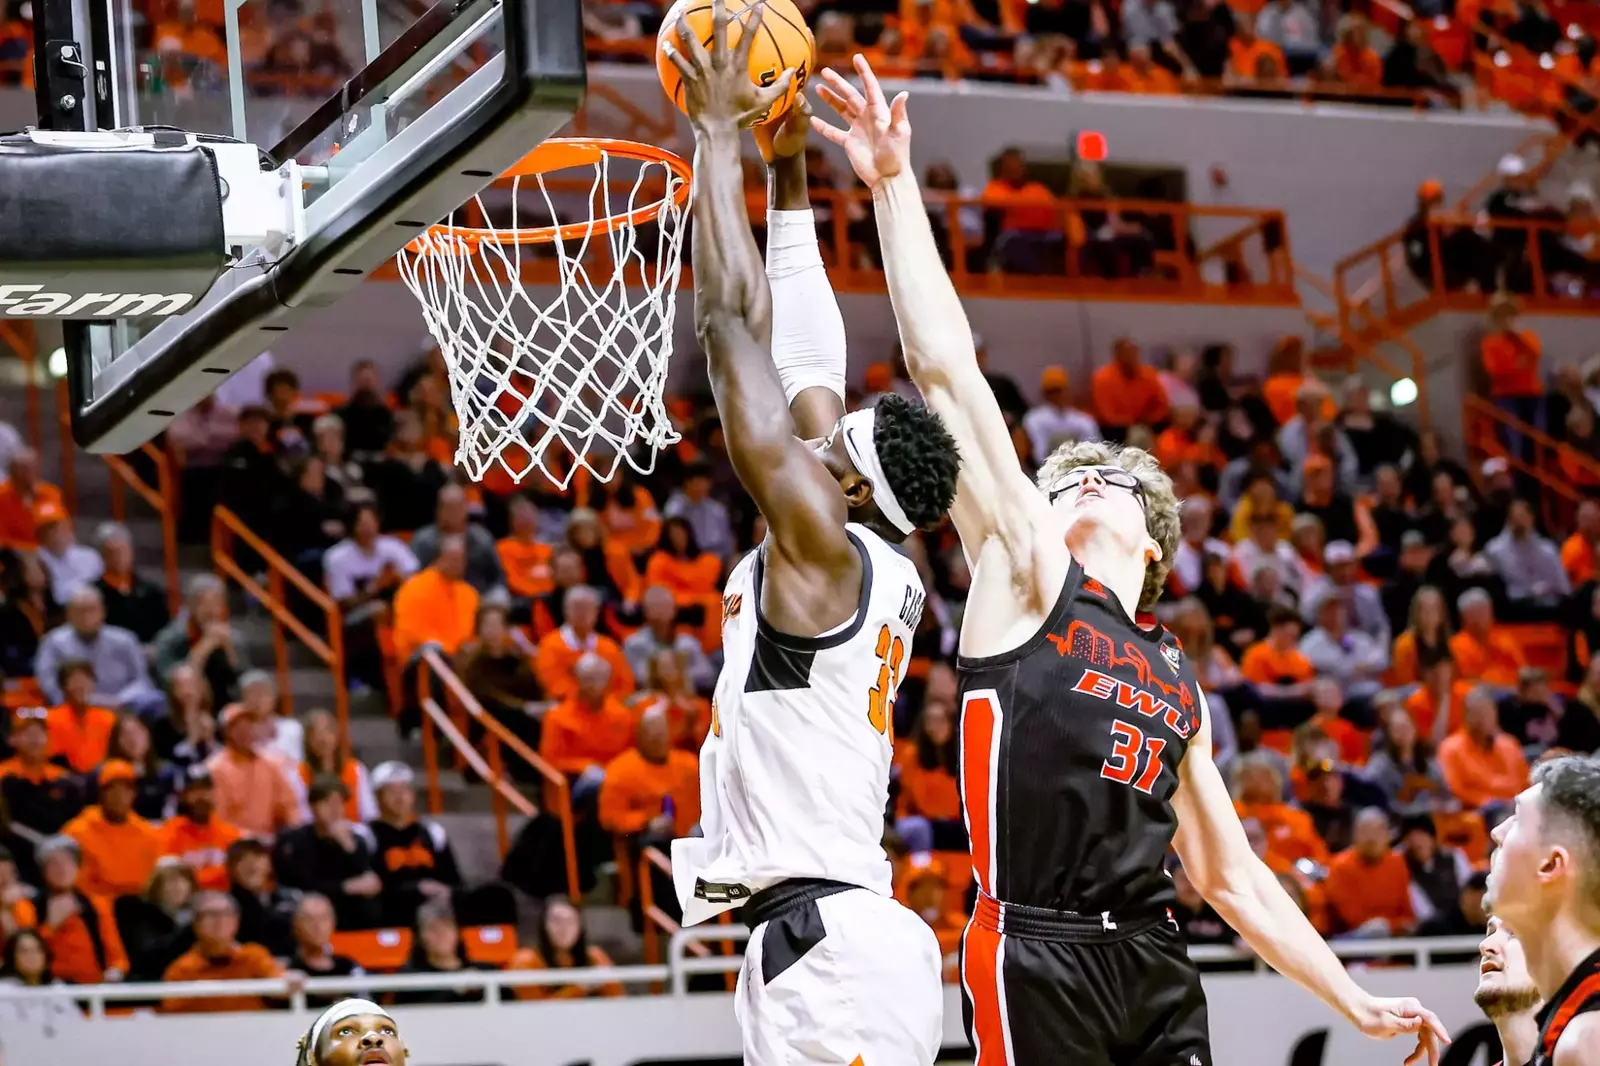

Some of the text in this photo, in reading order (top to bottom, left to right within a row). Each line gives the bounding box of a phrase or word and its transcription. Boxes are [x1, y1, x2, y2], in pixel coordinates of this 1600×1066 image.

[0, 284, 193, 316] Farm
[1070, 668, 1191, 740] EWU
[1100, 718, 1168, 795] 31
